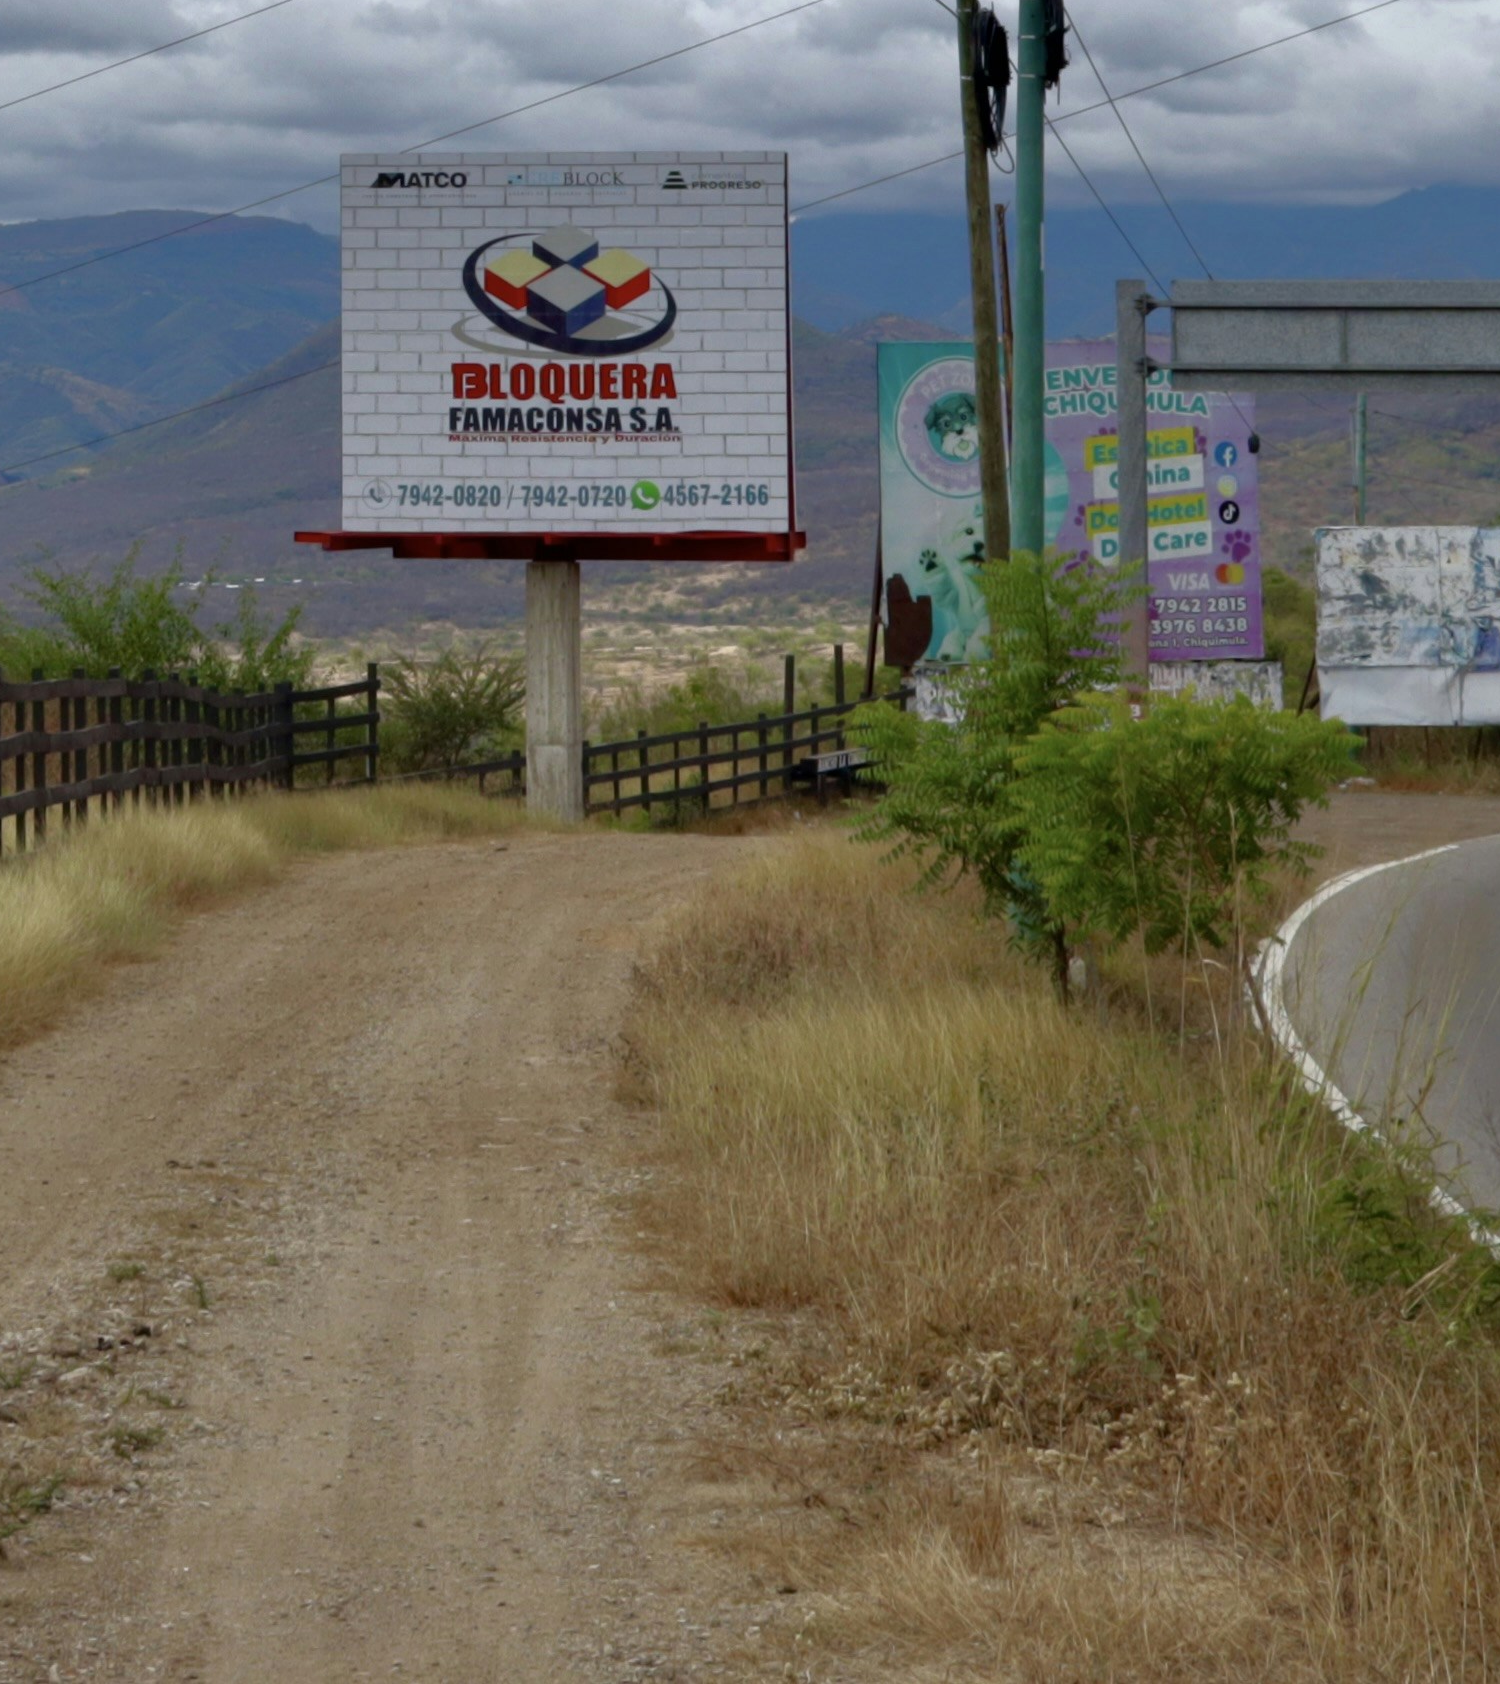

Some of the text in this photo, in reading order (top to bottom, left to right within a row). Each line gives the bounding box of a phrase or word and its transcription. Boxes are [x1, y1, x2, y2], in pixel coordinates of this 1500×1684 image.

[370, 172, 467, 188] MATCO
[692, 181, 761, 189] PROGRESO
[451, 363, 677, 403] BLOQUERA
[921, 375, 946, 395] PET
[449, 407, 680, 432] FAMACONSA S.A.
[511, 435, 596, 443] Resistencia
[397, 484, 501, 507] 7942-0820
[521, 484, 627, 507] 7942-0720
[663, 484, 769, 506] 4567-2166
[1153, 531, 1208, 552] Care
[1168, 572, 1211, 591] VISA
[1155, 597, 1247, 614] 7942 2815
[1151, 618, 1248, 634] 3976 8438
